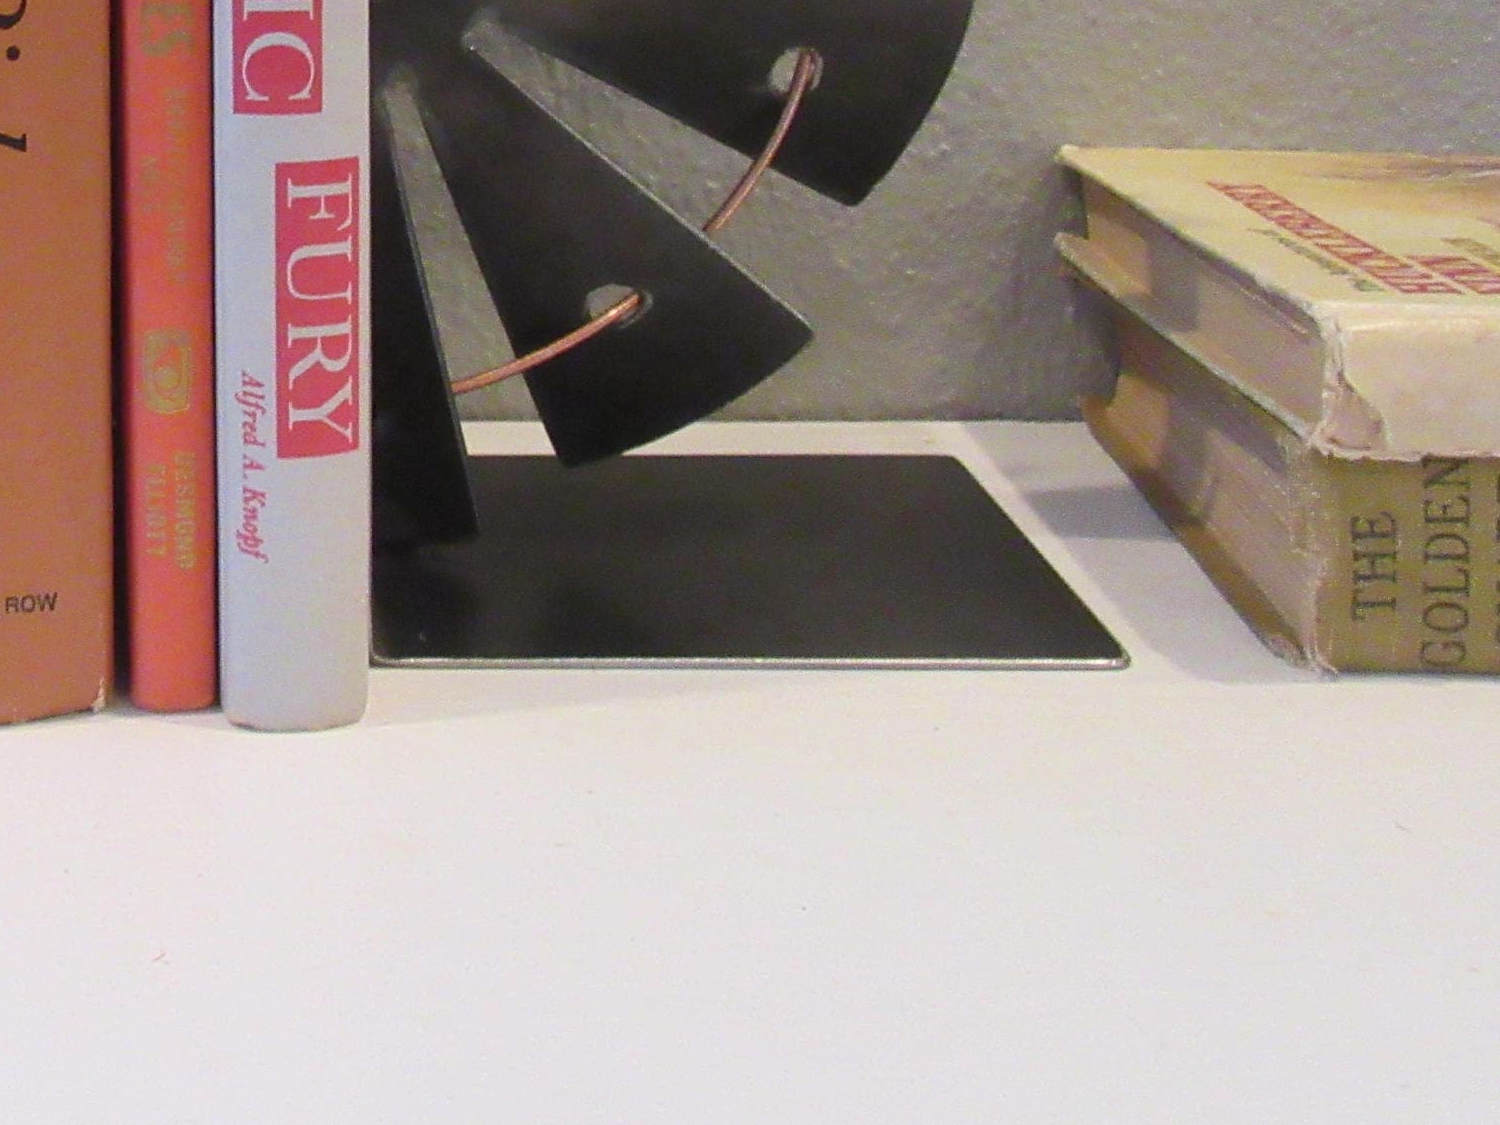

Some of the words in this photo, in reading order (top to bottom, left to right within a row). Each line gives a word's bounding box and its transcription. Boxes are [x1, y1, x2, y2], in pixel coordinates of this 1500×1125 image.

[286, 173, 354, 444] FURY
[235, 370, 267, 448] Alfred
[242, 454, 266, 480] A.
[235, 484, 269, 564] Knopf
[1419, 453, 1472, 667] GOLDEN
[5, 591, 59, 614] ROW
[1350, 511, 1398, 621] THE
